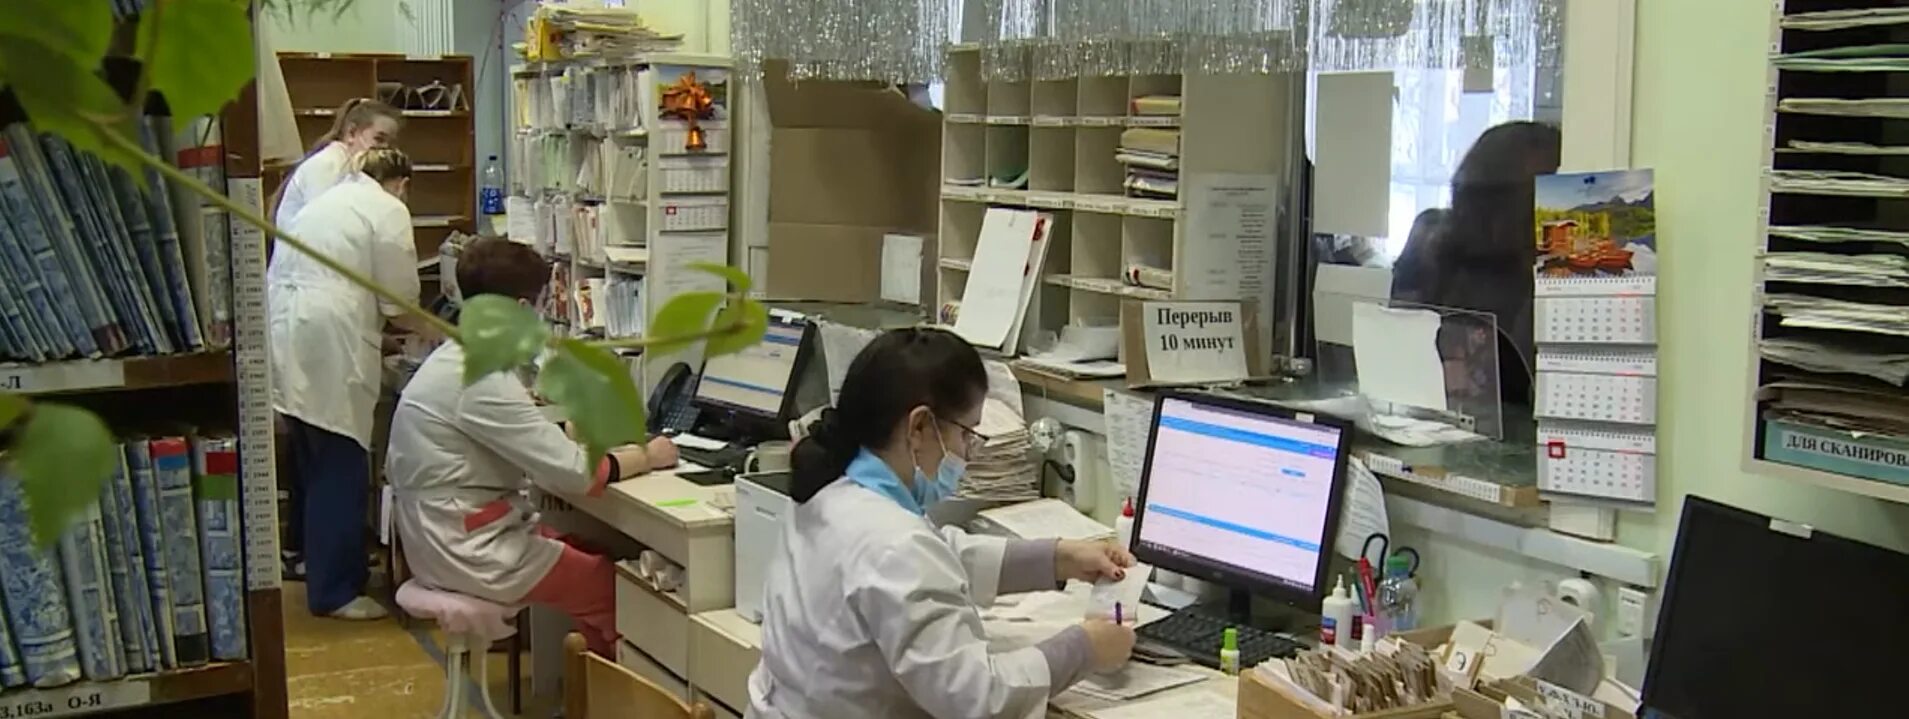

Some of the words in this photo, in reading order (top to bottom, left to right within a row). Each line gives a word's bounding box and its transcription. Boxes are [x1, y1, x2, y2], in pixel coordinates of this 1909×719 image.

[1157, 308, 1233, 329] Перерыв
[1159, 333, 1179, 352] 10
[1183, 334, 1235, 354] минут
[1786, 434, 1817, 451] ДЛЯ
[67, 692, 102, 709] О-Я
